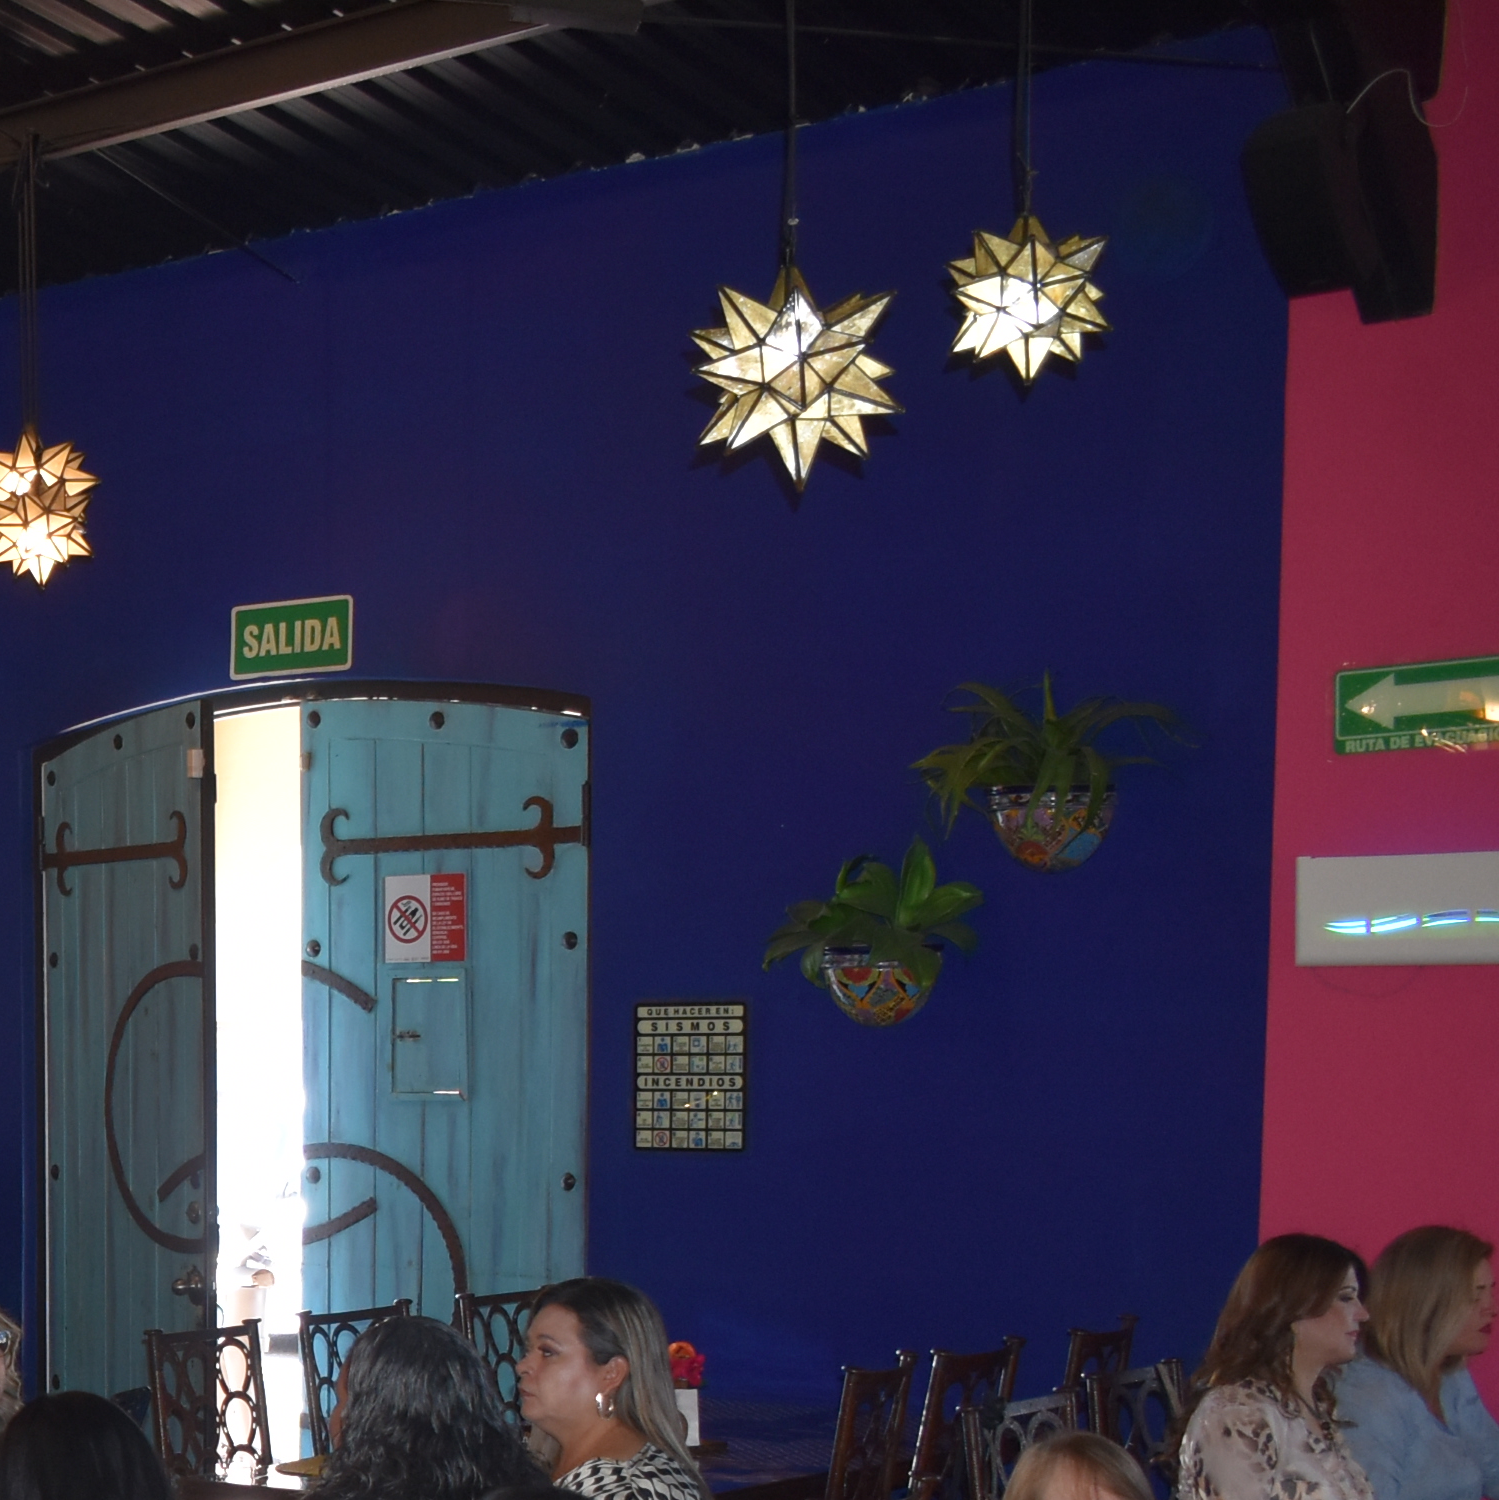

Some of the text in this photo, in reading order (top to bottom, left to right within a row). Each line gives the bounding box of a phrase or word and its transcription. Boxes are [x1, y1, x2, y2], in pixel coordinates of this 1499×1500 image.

[242, 617, 341, 659] SALIDA
[1345, 739, 1385, 753] RUTA
[1389, 736, 1410, 749] DE
[646, 1008, 669, 1016] QUE
[673, 1007, 712, 1015] HACER
[650, 1021, 731, 1032] SISMOS
[643, 1077, 737, 1087] INCENDIOS
